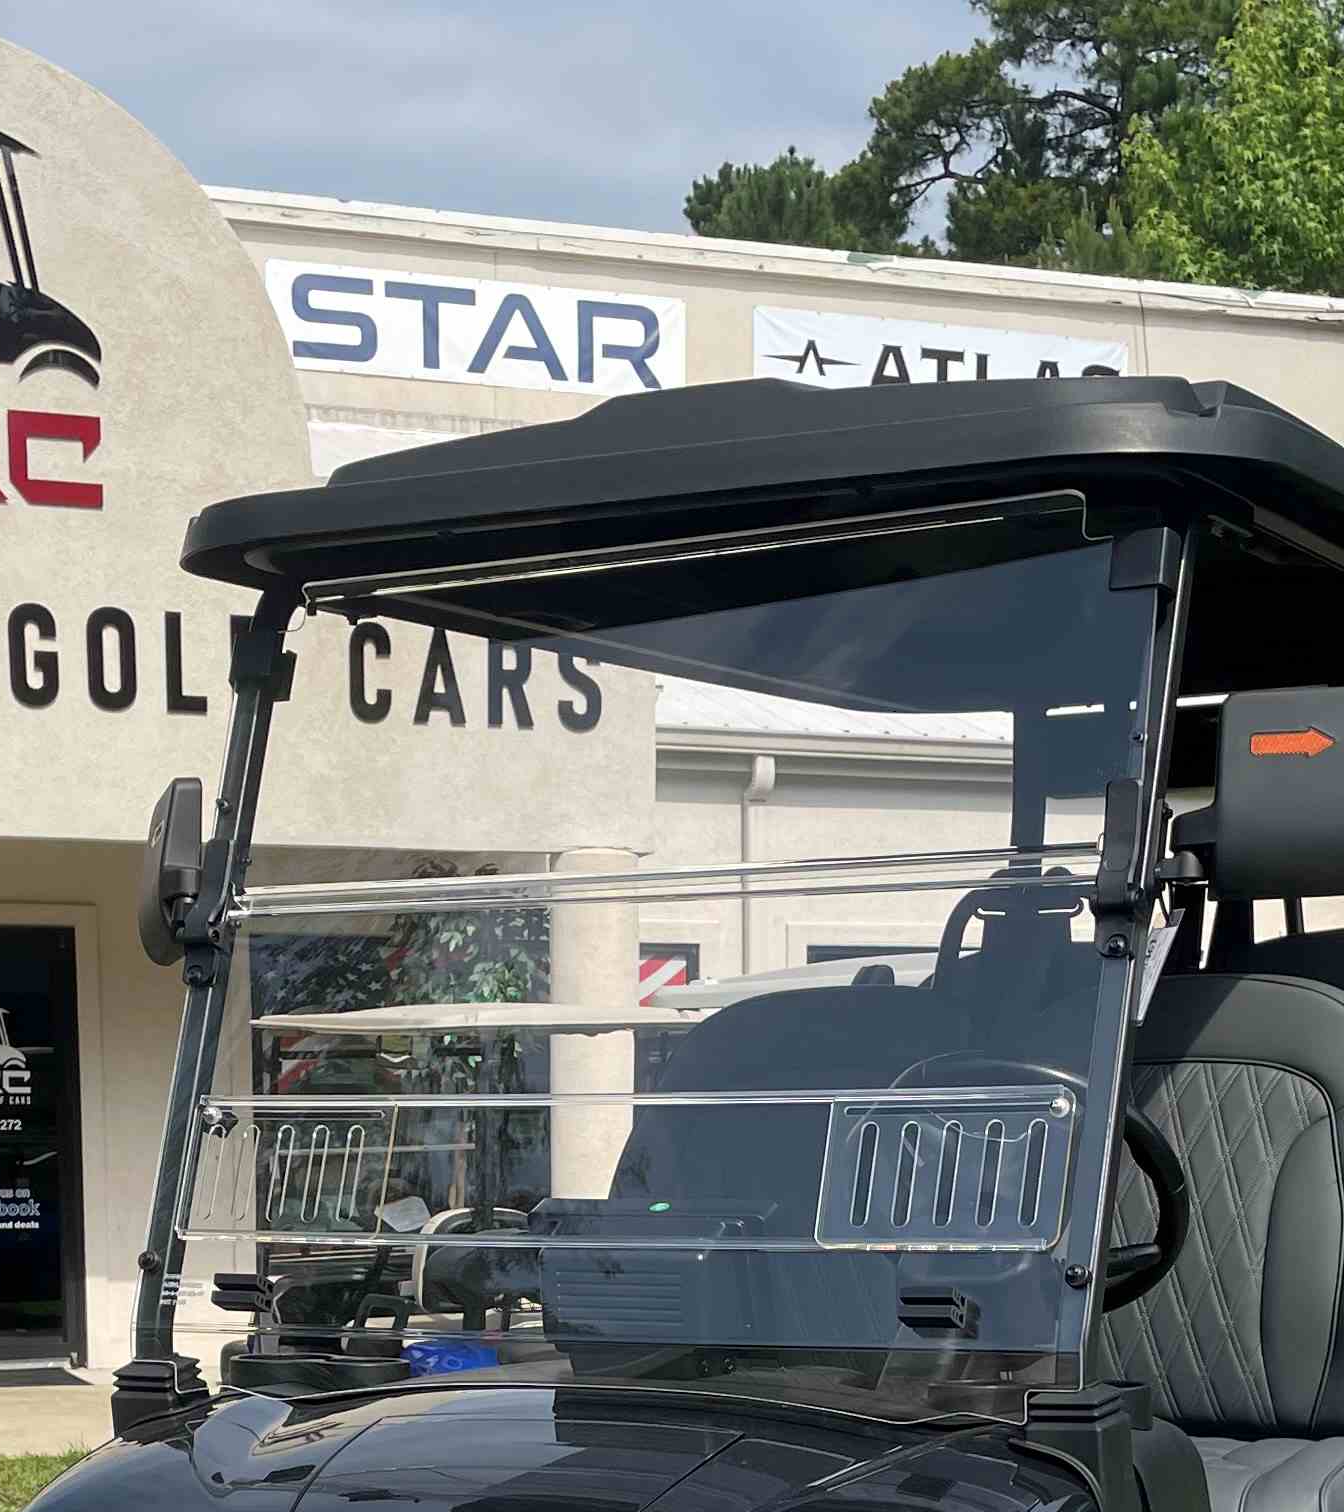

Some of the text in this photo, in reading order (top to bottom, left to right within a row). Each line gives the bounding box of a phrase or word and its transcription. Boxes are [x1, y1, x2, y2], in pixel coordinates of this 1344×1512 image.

[292, 274, 662, 389] STAR
[871, 344, 1121, 386] ATL
[7, 602, 256, 714] GOL
[349, 622, 603, 733] CARS
[0, 1189, 14, 1198] us
[15, 1188, 31, 1198] on
[14, 1220, 39, 1229] deals
